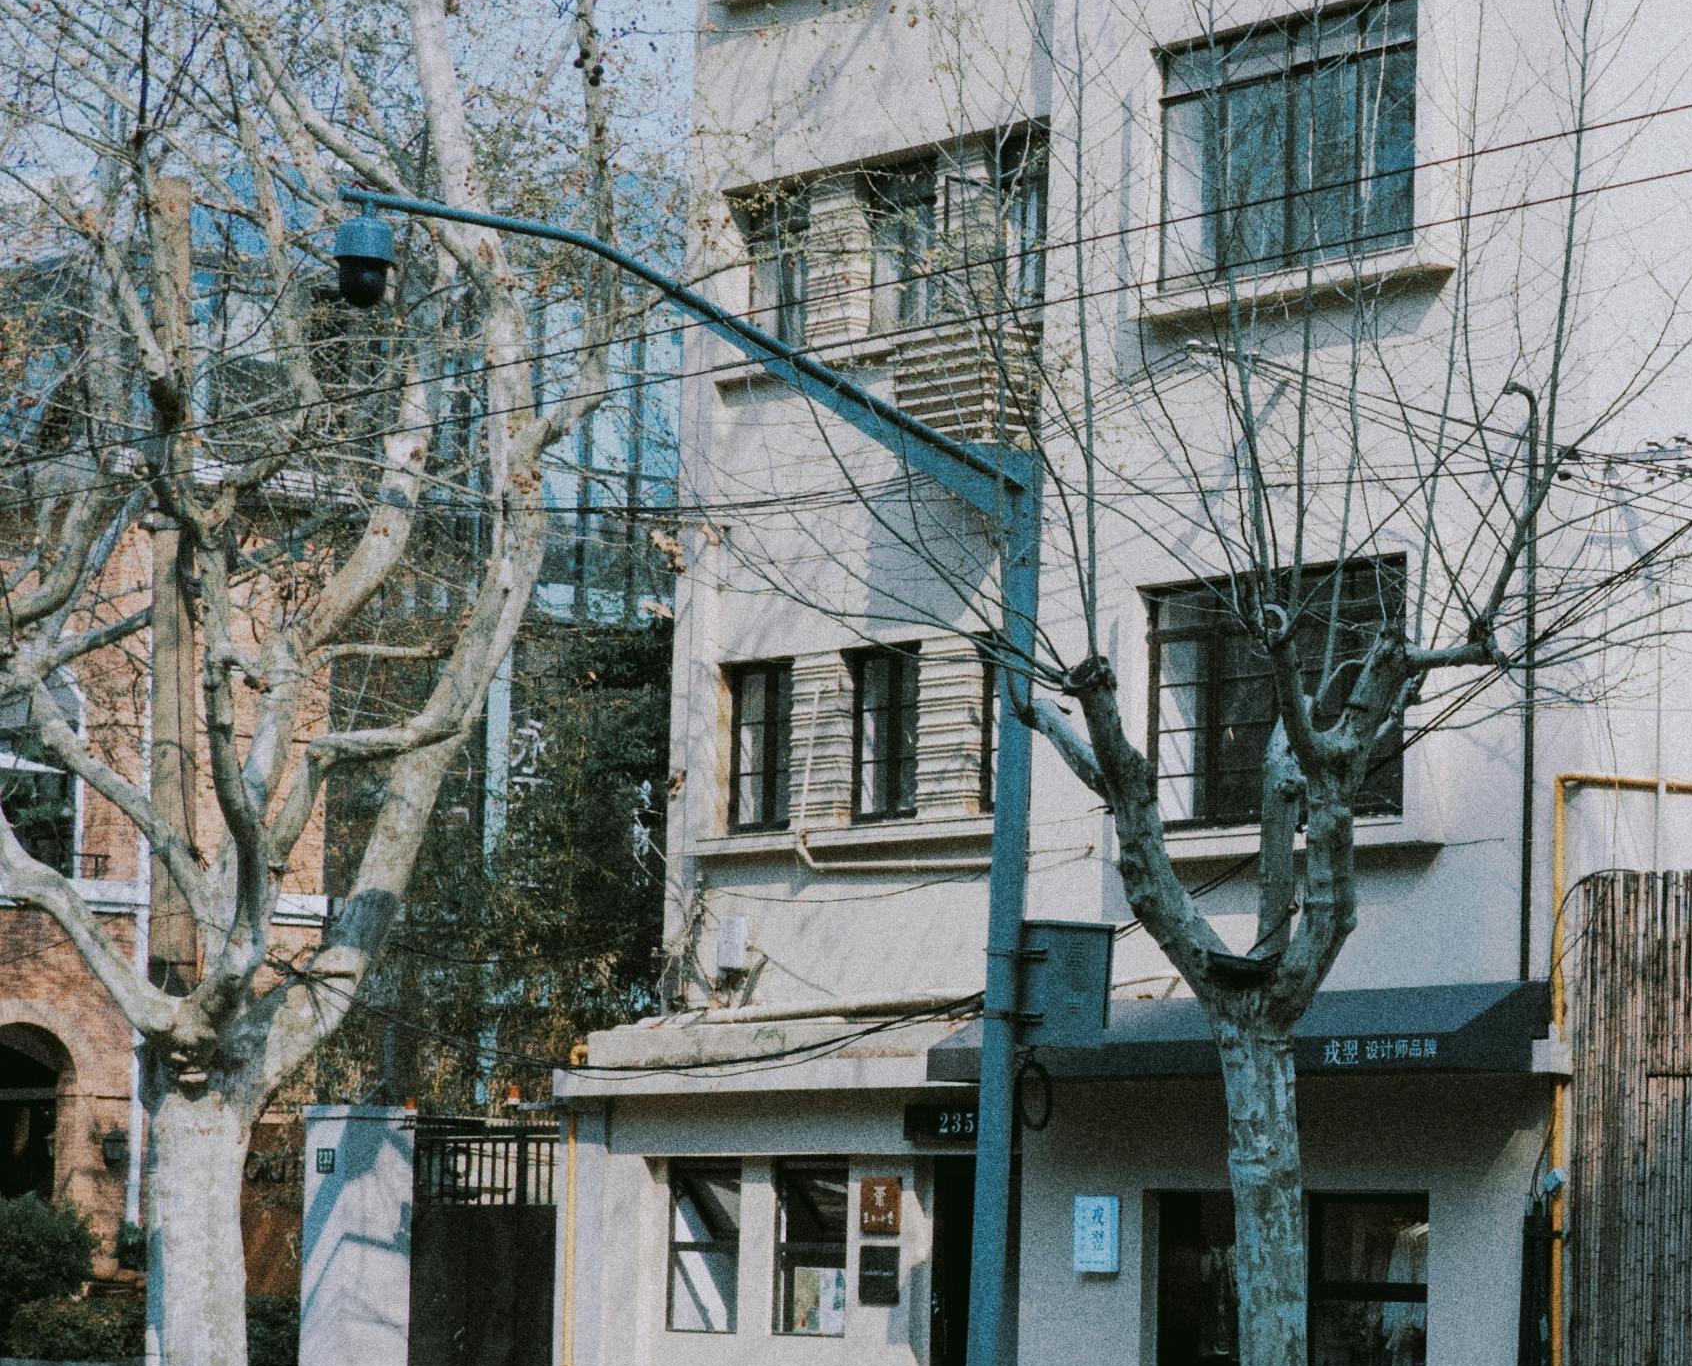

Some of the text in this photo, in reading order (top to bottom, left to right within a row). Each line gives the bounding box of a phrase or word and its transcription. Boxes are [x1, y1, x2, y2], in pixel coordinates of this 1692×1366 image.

[1365, 1037, 1438, 1060] 设计师品牌
[939, 1112, 974, 1133] 235
